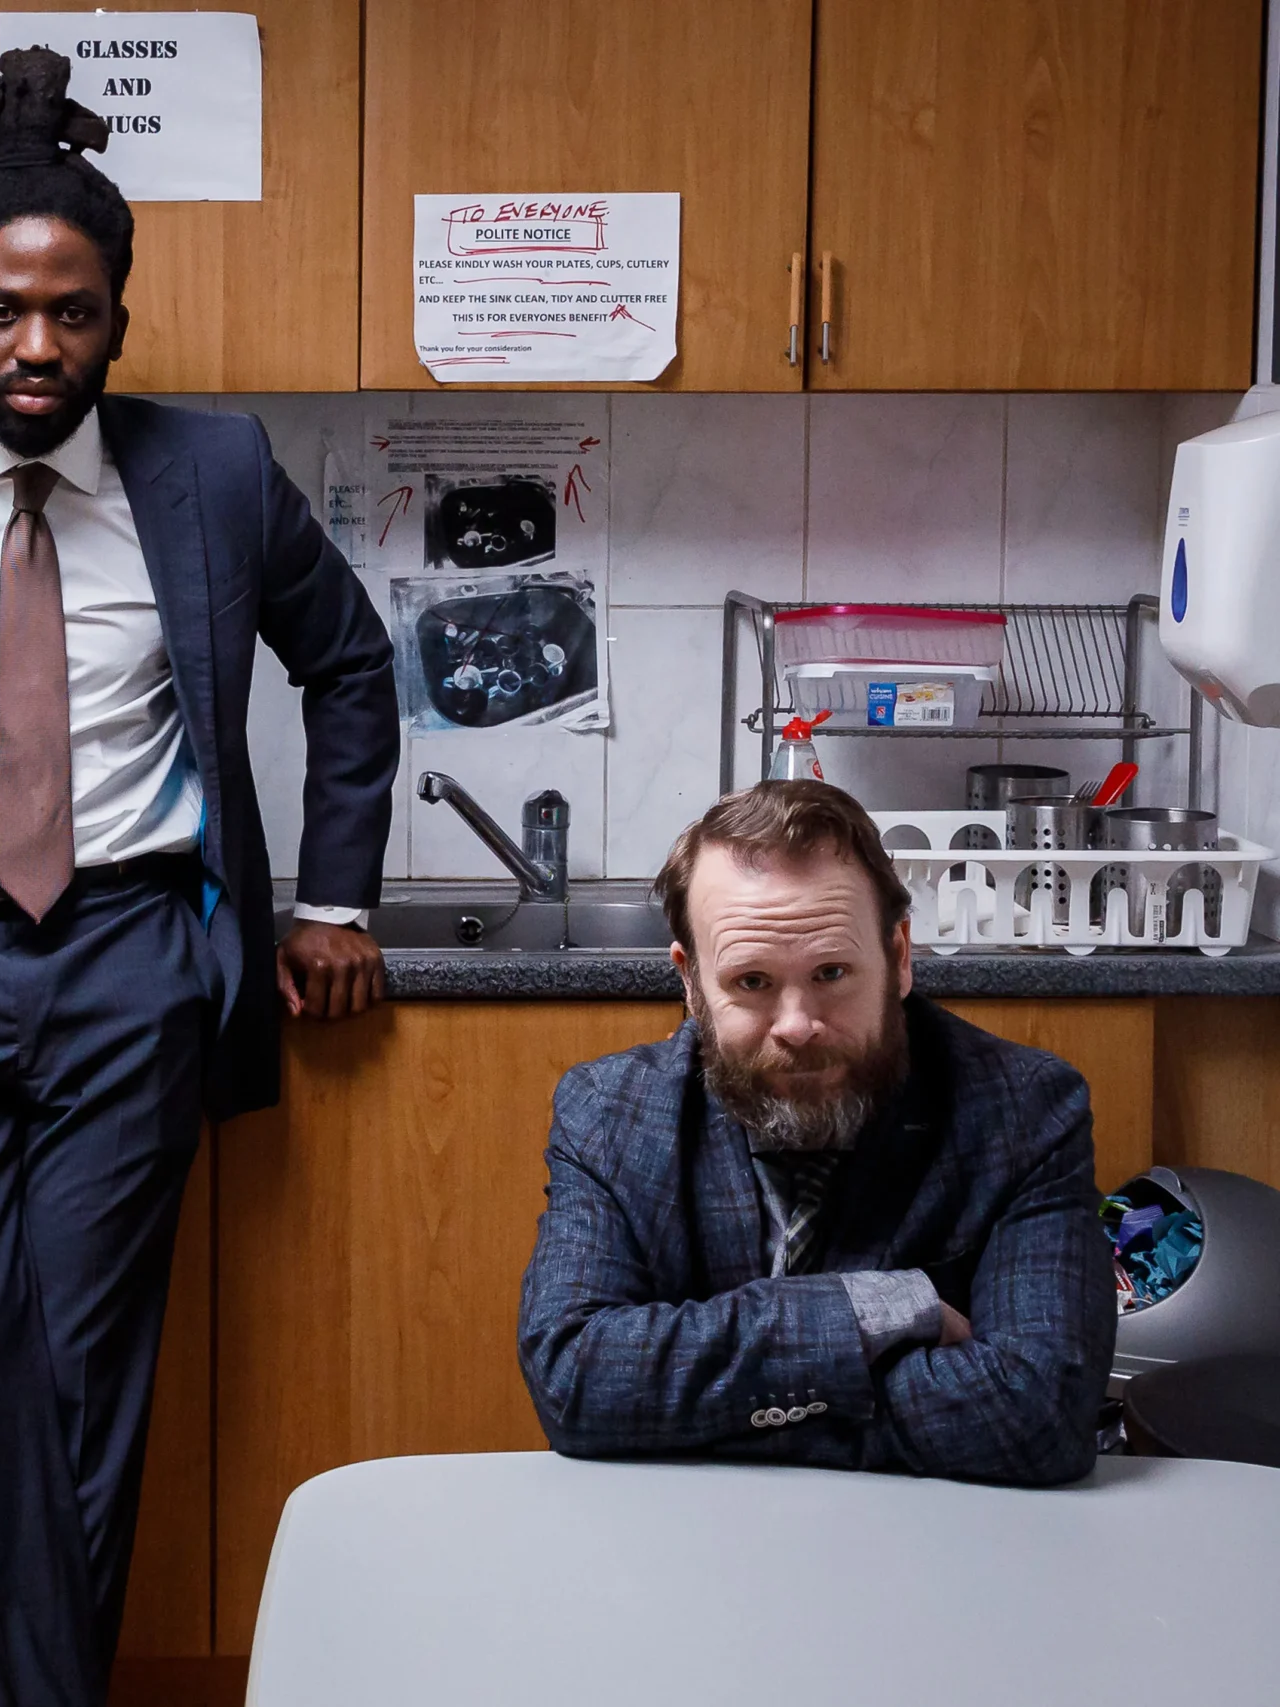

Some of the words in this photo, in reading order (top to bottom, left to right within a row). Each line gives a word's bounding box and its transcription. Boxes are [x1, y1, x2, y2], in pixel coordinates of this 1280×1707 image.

[76, 40, 178, 59] GLASSES
[102, 78, 152, 97] AND
[455, 203, 485, 224] TO
[476, 228, 520, 239] POLITE
[524, 228, 571, 239] NOTICE
[419, 259, 453, 270] PLEASE
[455, 259, 490, 270] KINDLY
[493, 259, 523, 270] WASH
[526, 259, 554, 270] YOUR
[556, 259, 594, 270] PLATES,
[596, 259, 624, 270] CUPS,
[627, 259, 670, 270] CUTLERY
[419, 294, 441, 304] AND
[443, 294, 466, 304] KEEP
[469, 294, 487, 304] THE
[490, 294, 512, 304] SINK
[515, 294, 549, 304] CLEAN,
[552, 294, 574, 304] TIDY
[576, 294, 598, 304] AND
[600, 294, 642, 304] CLUTTER
[645, 294, 668, 304] FREE
[452, 312, 474, 323] THIS
[476, 312, 485, 323] IS
[487, 312, 507, 323] FOR
[510, 312, 567, 323] EVERYONES
[569, 312, 608, 323] BENEFIT
[420, 344, 440, 353] Thank
[441, 344, 455, 353] you
[455, 344, 466, 353] for
[467, 344, 483, 353] your
[485, 344, 533, 353] consideration
[329, 485, 361, 494] PLEASE
[329, 517, 349, 525] AND
